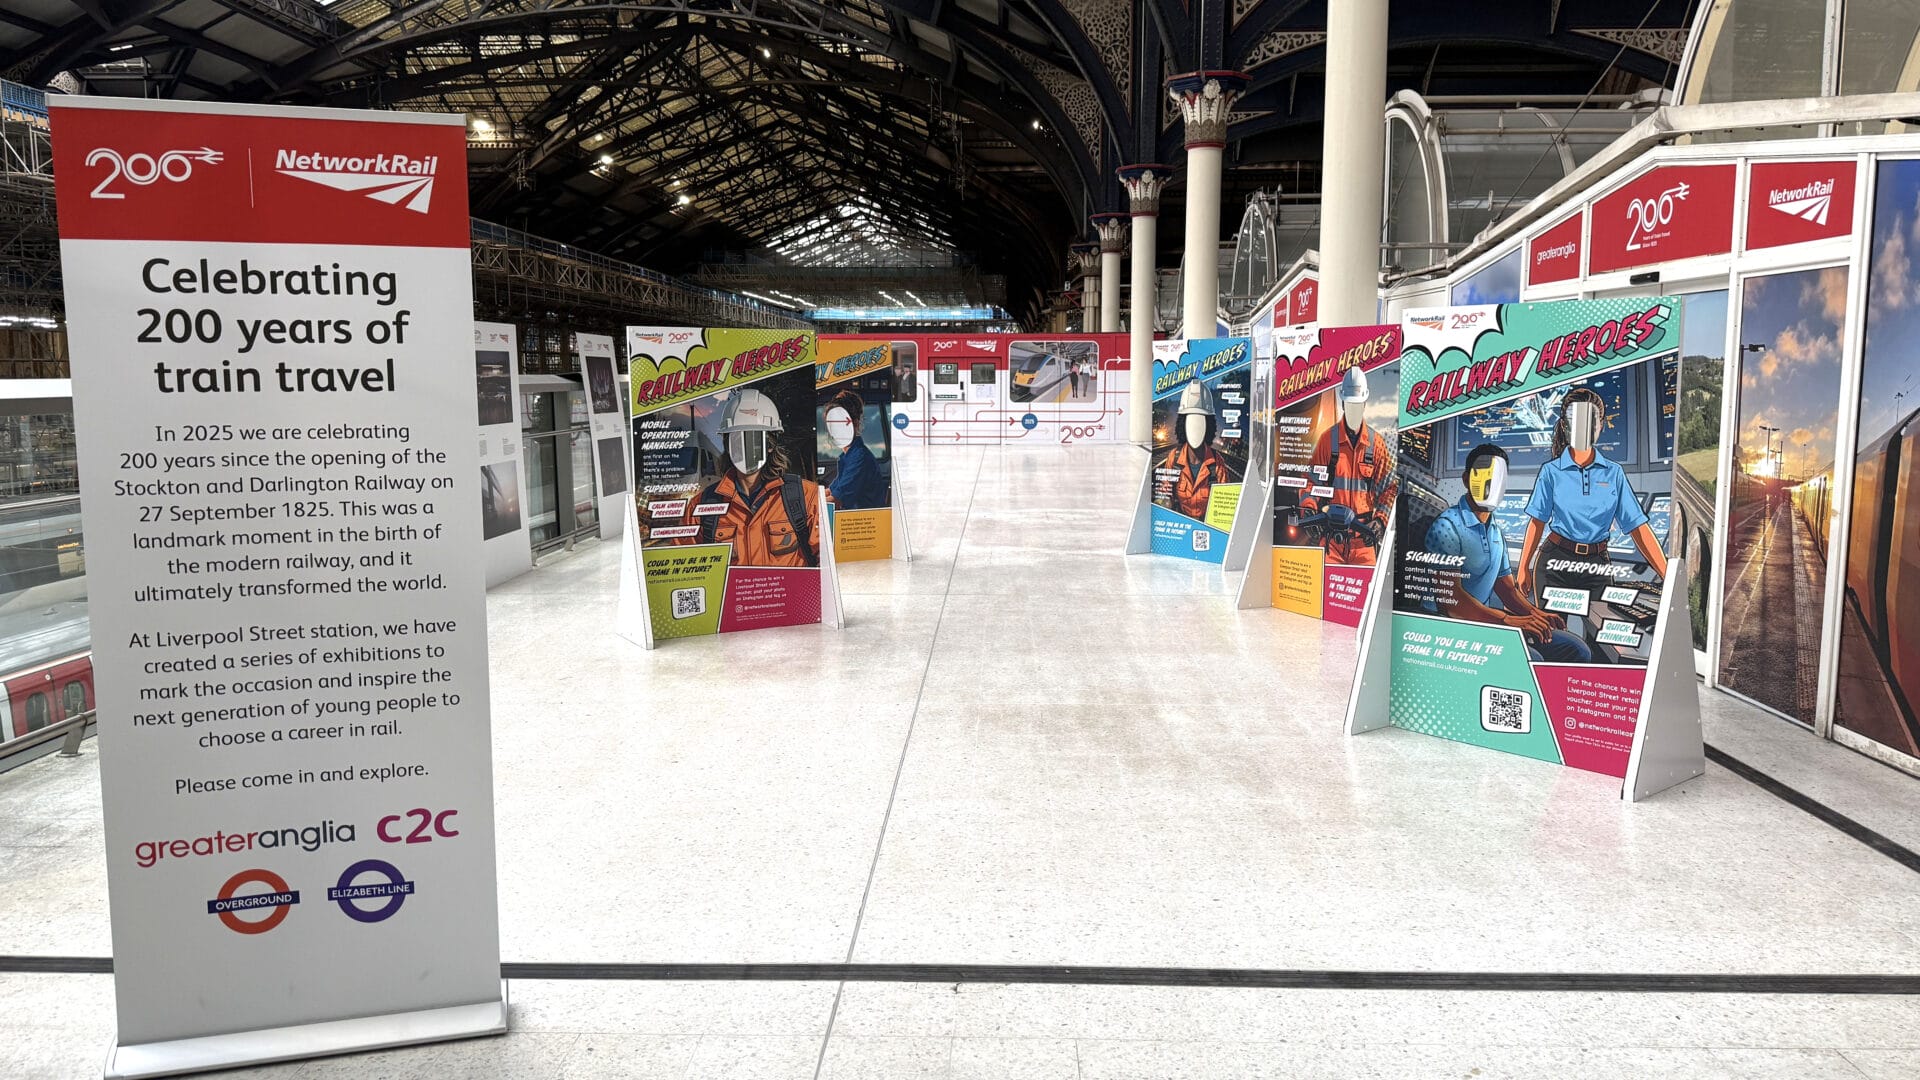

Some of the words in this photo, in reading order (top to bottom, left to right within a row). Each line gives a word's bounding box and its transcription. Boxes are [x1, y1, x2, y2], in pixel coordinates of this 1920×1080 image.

[276, 149, 438, 175] NetworkRail
[85, 147, 193, 199] 200
[1769, 178, 1835, 205] NetworkRail
[1626, 193, 1673, 251] 200
[1537, 242, 1575, 265] greateranglia
[142, 258, 396, 306] Celebrating
[137, 308, 222, 343] 200
[236, 319, 352, 353] years
[366, 310, 410, 344] of
[1452, 314, 1477, 329] 200
[933, 341, 952, 351] 200
[833, 344, 888, 377] HEROES
[1155, 360, 1203, 395] RAILWAY
[1202, 340, 1248, 375] HEROES
[1278, 357, 1338, 400] RAILWAY
[1336, 330, 1397, 376] HEROES
[1406, 346, 1540, 416] RAILWAY
[1536, 304, 1672, 378] HEROES
[154, 360, 261, 393] train
[275, 358, 395, 392] travel
[637, 358, 733, 407] RAILWAY
[732, 334, 811, 379] HEROES
[155, 426, 175, 441] In
[183, 425, 233, 441] 2025
[239, 429, 266, 440] we
[272, 428, 301, 440] are
[307, 424, 409, 442] celebrating
[641, 420, 671, 429] MOBILE
[642, 431, 691, 439] OPERATIONS
[1061, 426, 1095, 443] 200
[641, 441, 685, 450] MANAGERS
[120, 453, 157, 469] 200
[164, 456, 215, 472] years
[221, 452, 269, 467] since
[275, 450, 305, 466] the
[311, 450, 385, 469] opening
[392, 448, 411, 464] of
[416, 448, 446, 463] the
[114, 479, 200, 496] Stockton
[207, 477, 243, 494] and
[250, 476, 348, 495] Darlington
[355, 475, 425, 493] Railway
[431, 477, 453, 488] on
[644, 483, 701, 493] SUPERPOWERS:
[140, 506, 163, 522] 27
[170, 503, 276, 525] September
[282, 502, 334, 517] 1825.
[339, 501, 376, 516] This
[382, 504, 417, 515] was
[423, 503, 434, 514] a
[134, 530, 226, 549] landmark
[232, 529, 312, 545] moment
[318, 529, 333, 542] in
[339, 527, 369, 542] the
[375, 525, 417, 541] birth
[423, 524, 442, 539] of
[167, 558, 200, 574] the
[207, 555, 280, 573] modern
[287, 553, 354, 572] railway,
[360, 551, 394, 567] and
[401, 552, 413, 565] it
[1406, 551, 1466, 566] SIGNALLERS
[647, 568, 670, 576] FRAME
[682, 565, 712, 574] FUTURE?
[1440, 570, 1471, 579] movement
[1546, 559, 1633, 578] SUPERPOWERS:
[135, 583, 232, 602] ultimately
[238, 577, 351, 597] transformed
[357, 577, 387, 592] the
[392, 574, 446, 591] world.
[1430, 587, 1453, 596] running
[1548, 589, 1585, 600] DECISION-
[1607, 591, 1633, 601] LOGIC
[1437, 597, 1459, 606] reliably
[1550, 600, 1582, 611] MAKING
[1606, 622, 1632, 631] QUICK-
[1403, 631, 1432, 643] COULD
[1435, 636, 1454, 646] YOU
[1455, 640, 1468, 649] BE
[1470, 641, 1482, 652] IN
[1485, 644, 1504, 655] THE
[1599, 632, 1638, 643] THINKING
[1402, 644, 1432, 656] FRAME
[1434, 648, 1445, 658] IN
[1447, 651, 1488, 665] FUTURE?
[1568, 686, 1596, 696] Liverpool
[1600, 692, 1619, 700] Street
[1594, 682, 1618, 691] chance
[1567, 697, 1593, 706] voucher,
[1577, 706, 1610, 717] Instagram
[176, 778, 236, 794] Please
[242, 774, 292, 788] come
[299, 770, 314, 783] in
[320, 766, 353, 782] and
[360, 763, 428, 783] explore.
[377, 808, 459, 844] c2c
[135, 821, 355, 868] greateranglia
[332, 886, 385, 898] ELIZABETH
[387, 884, 410, 894] LINE
[216, 893, 292, 911] OVERGROUND
